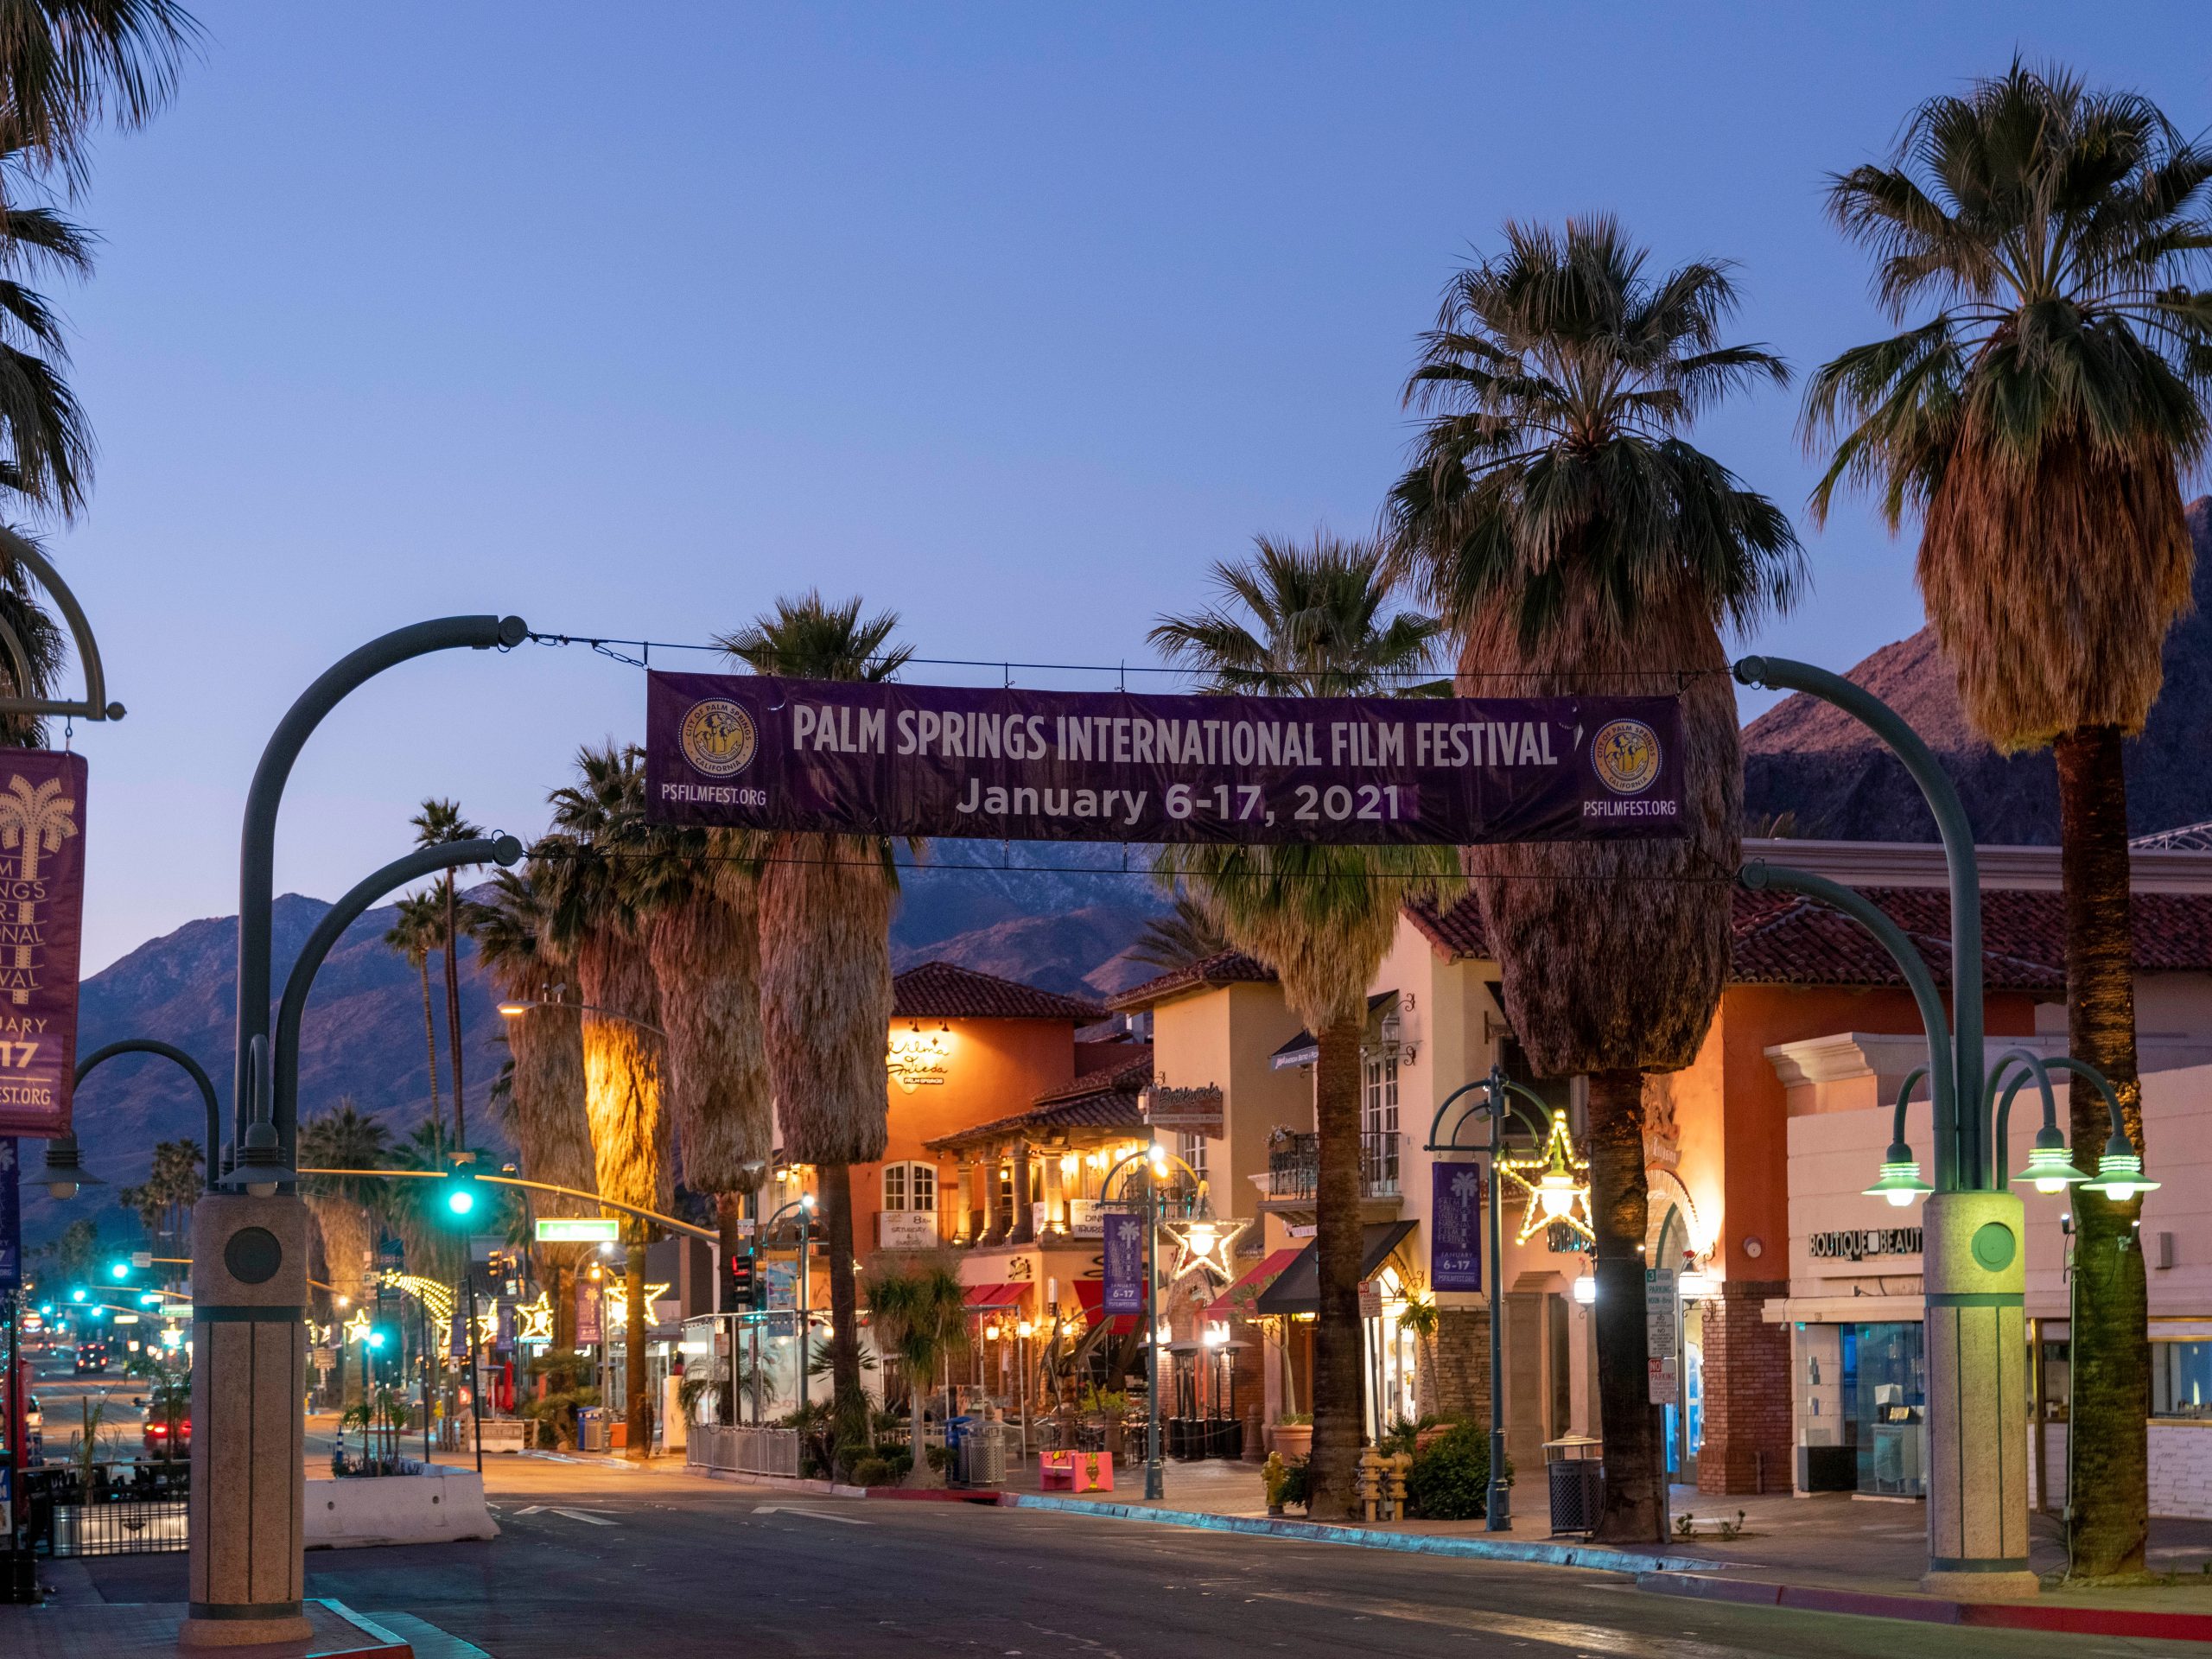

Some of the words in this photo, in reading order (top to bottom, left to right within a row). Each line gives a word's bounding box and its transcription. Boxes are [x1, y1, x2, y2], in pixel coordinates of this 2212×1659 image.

[685, 720, 696, 737] CITY
[694, 709, 704, 719] OF
[705, 703, 728, 713] PALM
[729, 708, 753, 741] SPRINGS
[793, 704, 886, 754] PALM
[897, 709, 1047, 760] SPRINGS
[1057, 716, 1323, 766] INTERNATIONAL
[1331, 722, 1405, 767] FILM
[1415, 721, 1558, 767] FESTIVAL
[1635, 726, 1656, 758] SPRINGS
[695, 757, 742, 772] CALIFORNIA
[1608, 776, 1649, 790] CALIFORNIA
[662, 784, 766, 806] PSFILMFEST.ORG
[956, 778, 1148, 825] January
[1166, 784, 1275, 828] 6-17,
[1294, 785, 1400, 821] 2021
[1583, 800, 1676, 817] PSFILMFEST.ORG
[1809, 1230, 1868, 1261] BOUTIQUE
[1443, 1260, 1471, 1270] 6-17
[1648, 1271, 1655, 1281] 3
[1113, 1289, 1135, 1298] 6-17
[1359, 1283, 1369, 1293] NO
[1649, 1285, 1672, 1294] PARKING
[1650, 1361, 1661, 1371] NO
[1650, 1372, 1675, 1381] PARKING
